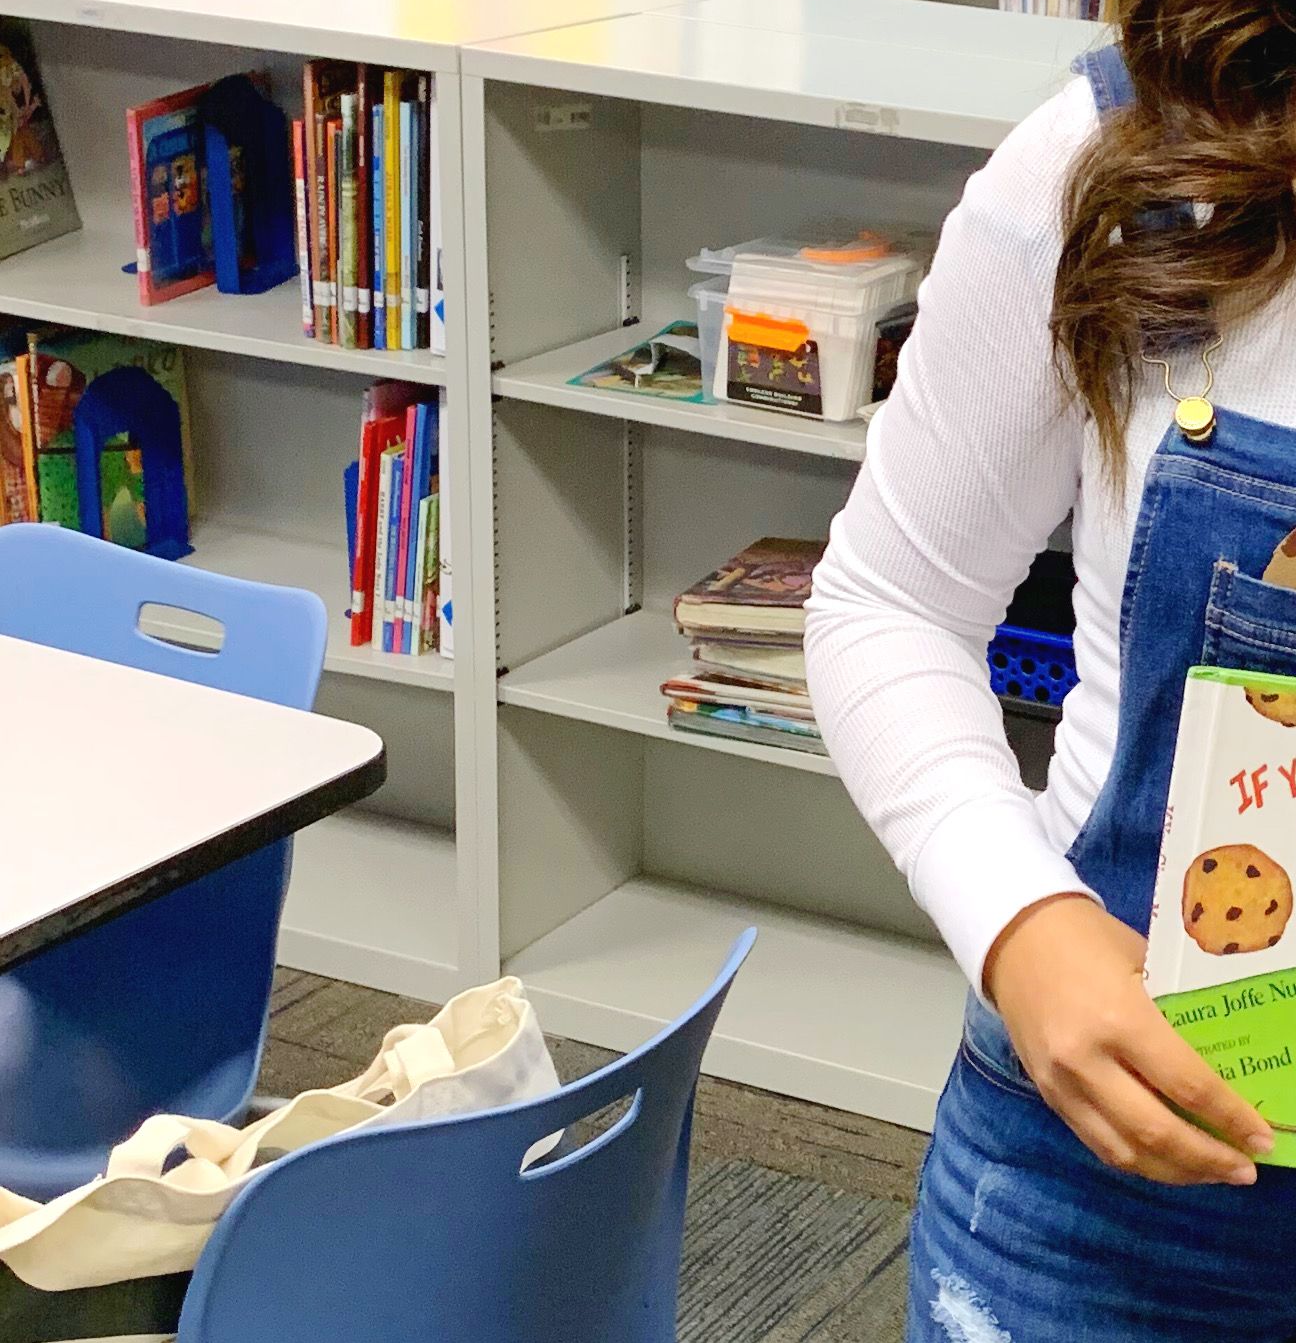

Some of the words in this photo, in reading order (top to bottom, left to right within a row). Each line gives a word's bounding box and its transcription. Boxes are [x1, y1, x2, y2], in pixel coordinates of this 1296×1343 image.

[1230, 764, 1268, 814] IF
[1161, 1002, 1218, 1028] Laura
[1221, 987, 1265, 1017] Joffe
[1195, 1038, 1236, 1056] TRATED
[1238, 1046, 1293, 1077] Bond
